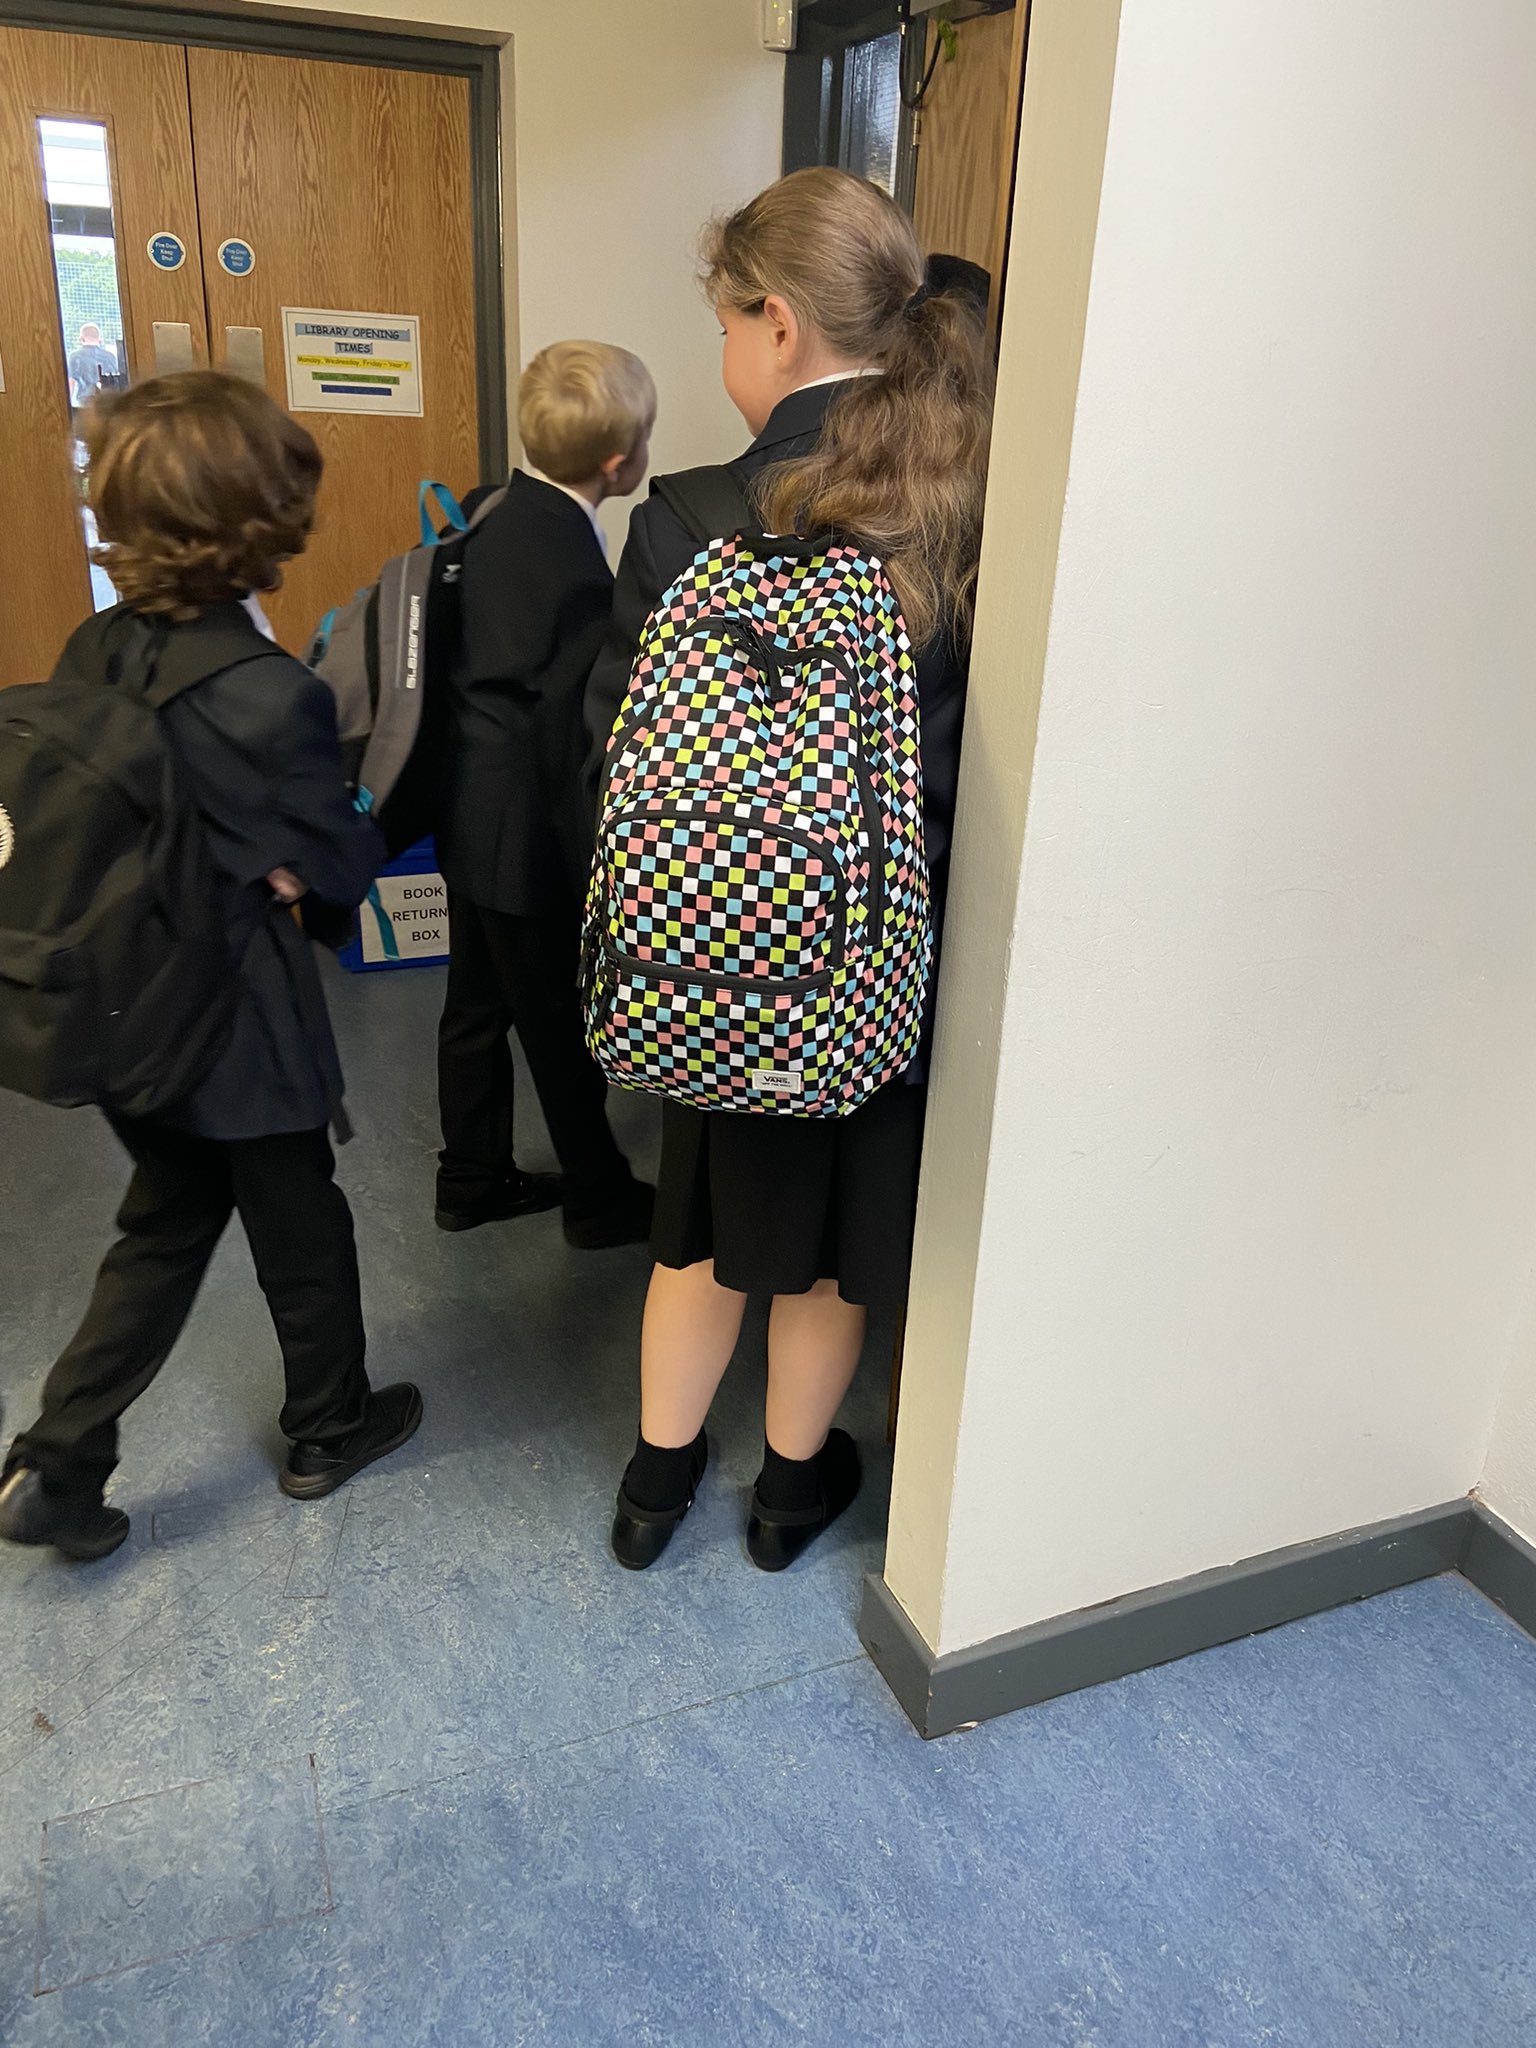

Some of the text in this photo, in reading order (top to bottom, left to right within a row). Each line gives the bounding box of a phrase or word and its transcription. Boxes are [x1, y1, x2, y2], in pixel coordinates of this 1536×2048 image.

[305, 325, 400, 340] LIBRARY OPENING
[337, 343, 371, 353] TIMES
[363, 359, 382, 369] Friday
[406, 594, 421, 689] SLAZENGER
[403, 886, 444, 899] BOOK
[392, 907, 448, 921] RETURN
[411, 929, 441, 941] BOX
